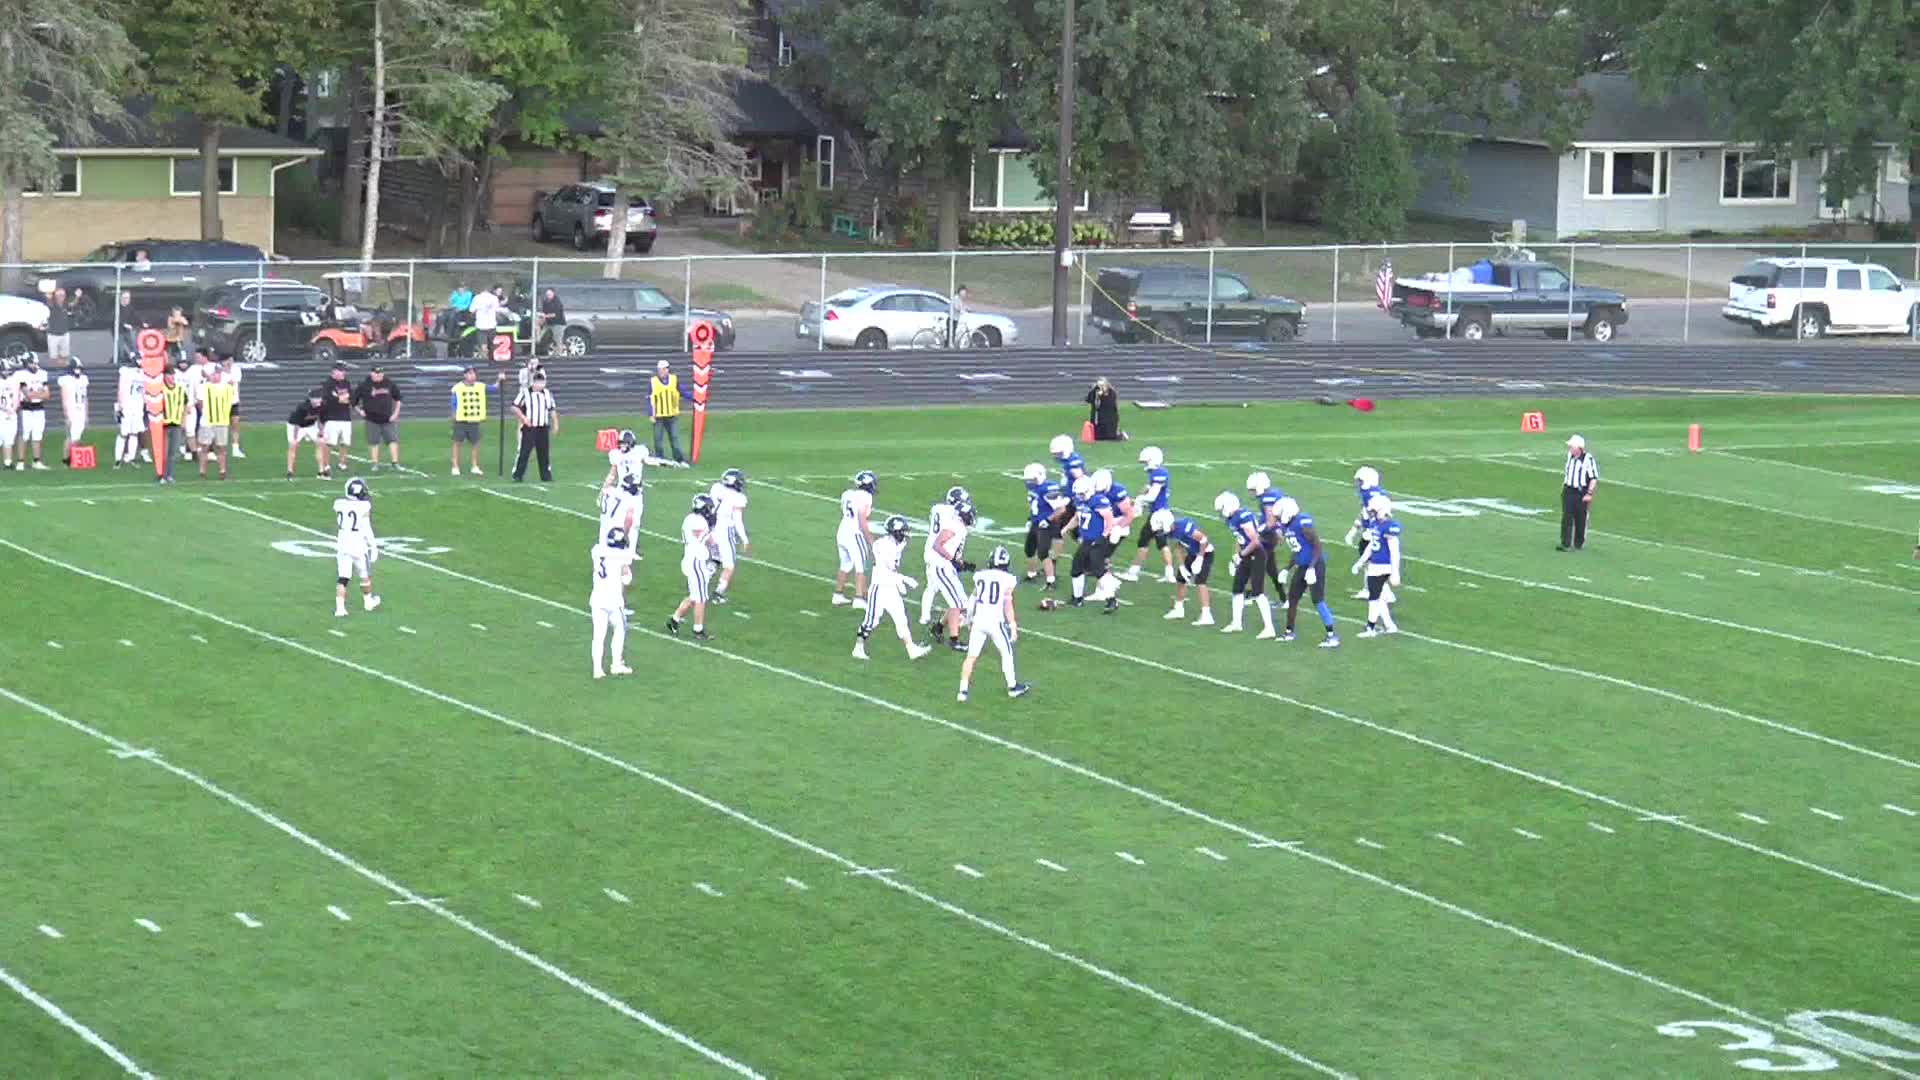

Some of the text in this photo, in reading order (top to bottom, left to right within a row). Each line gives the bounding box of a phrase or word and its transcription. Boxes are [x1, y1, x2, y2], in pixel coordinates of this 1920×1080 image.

[493, 335, 512, 361] 2
[1529, 415, 1540, 430] G
[603, 432, 618, 450] 20
[75, 449, 92, 466] 30
[337, 510, 359, 532] 22
[976, 579, 1000, 606] 20
[1656, 1009, 1920, 1072] 30
